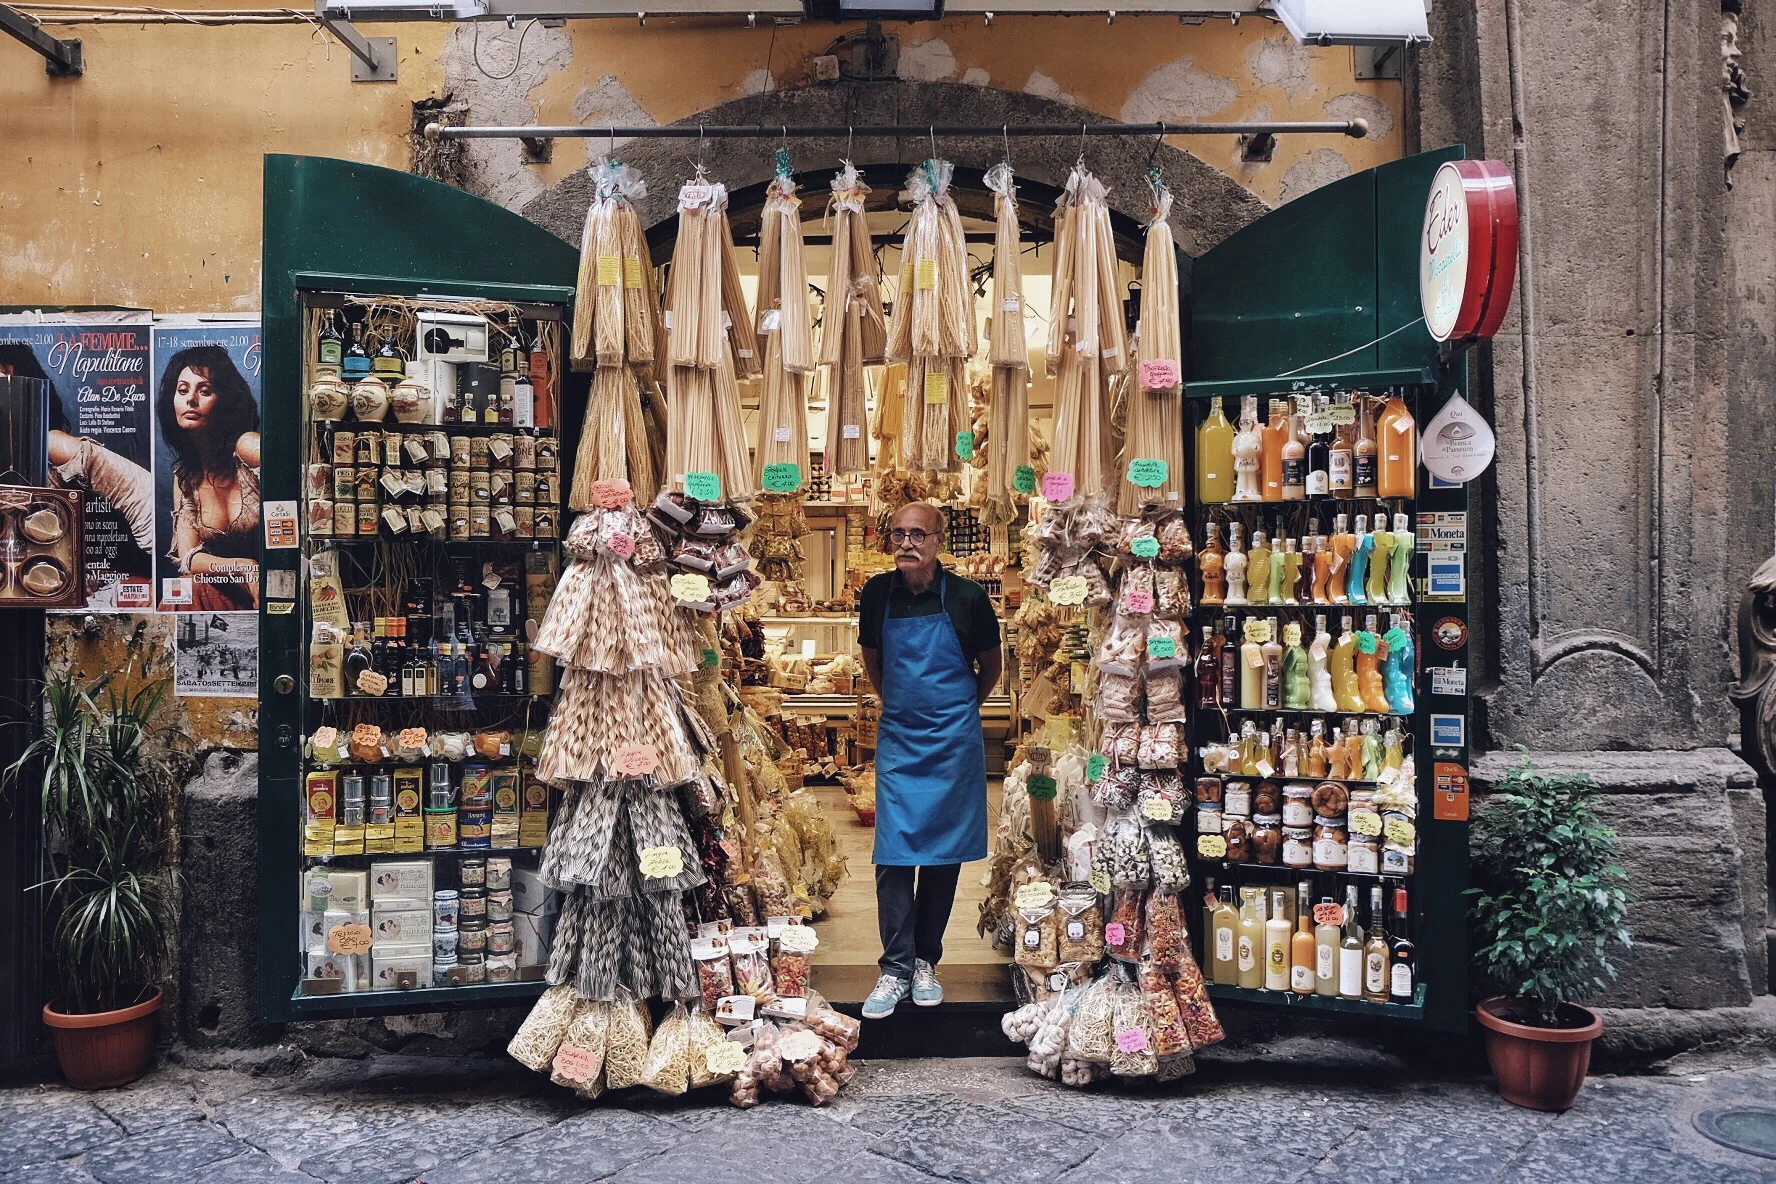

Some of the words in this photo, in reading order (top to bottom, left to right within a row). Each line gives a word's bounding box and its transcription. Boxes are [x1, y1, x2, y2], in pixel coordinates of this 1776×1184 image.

[1427, 185, 1462, 255] Eder
[22, 337, 34, 346] ore
[35, 333, 54, 345] 21.00
[158, 336, 178, 348] 17-18
[180, 335, 215, 348] settembre
[217, 338, 229, 347] ore
[230, 335, 249, 347] 21.00
[48, 341, 144, 382] Napulitane
[77, 386, 101, 403] Alan
[102, 386, 121, 403] De
[122, 384, 147, 406] Luca
[86, 497, 111, 513] artisti
[1430, 528, 1465, 540] Moneta
[91, 570, 130, 584] Maggiore
[193, 572, 228, 584] Chiostro
[229, 573, 244, 584] San
[123, 585, 143, 593] ESTATE
[1442, 677, 1465, 686] Moneta
